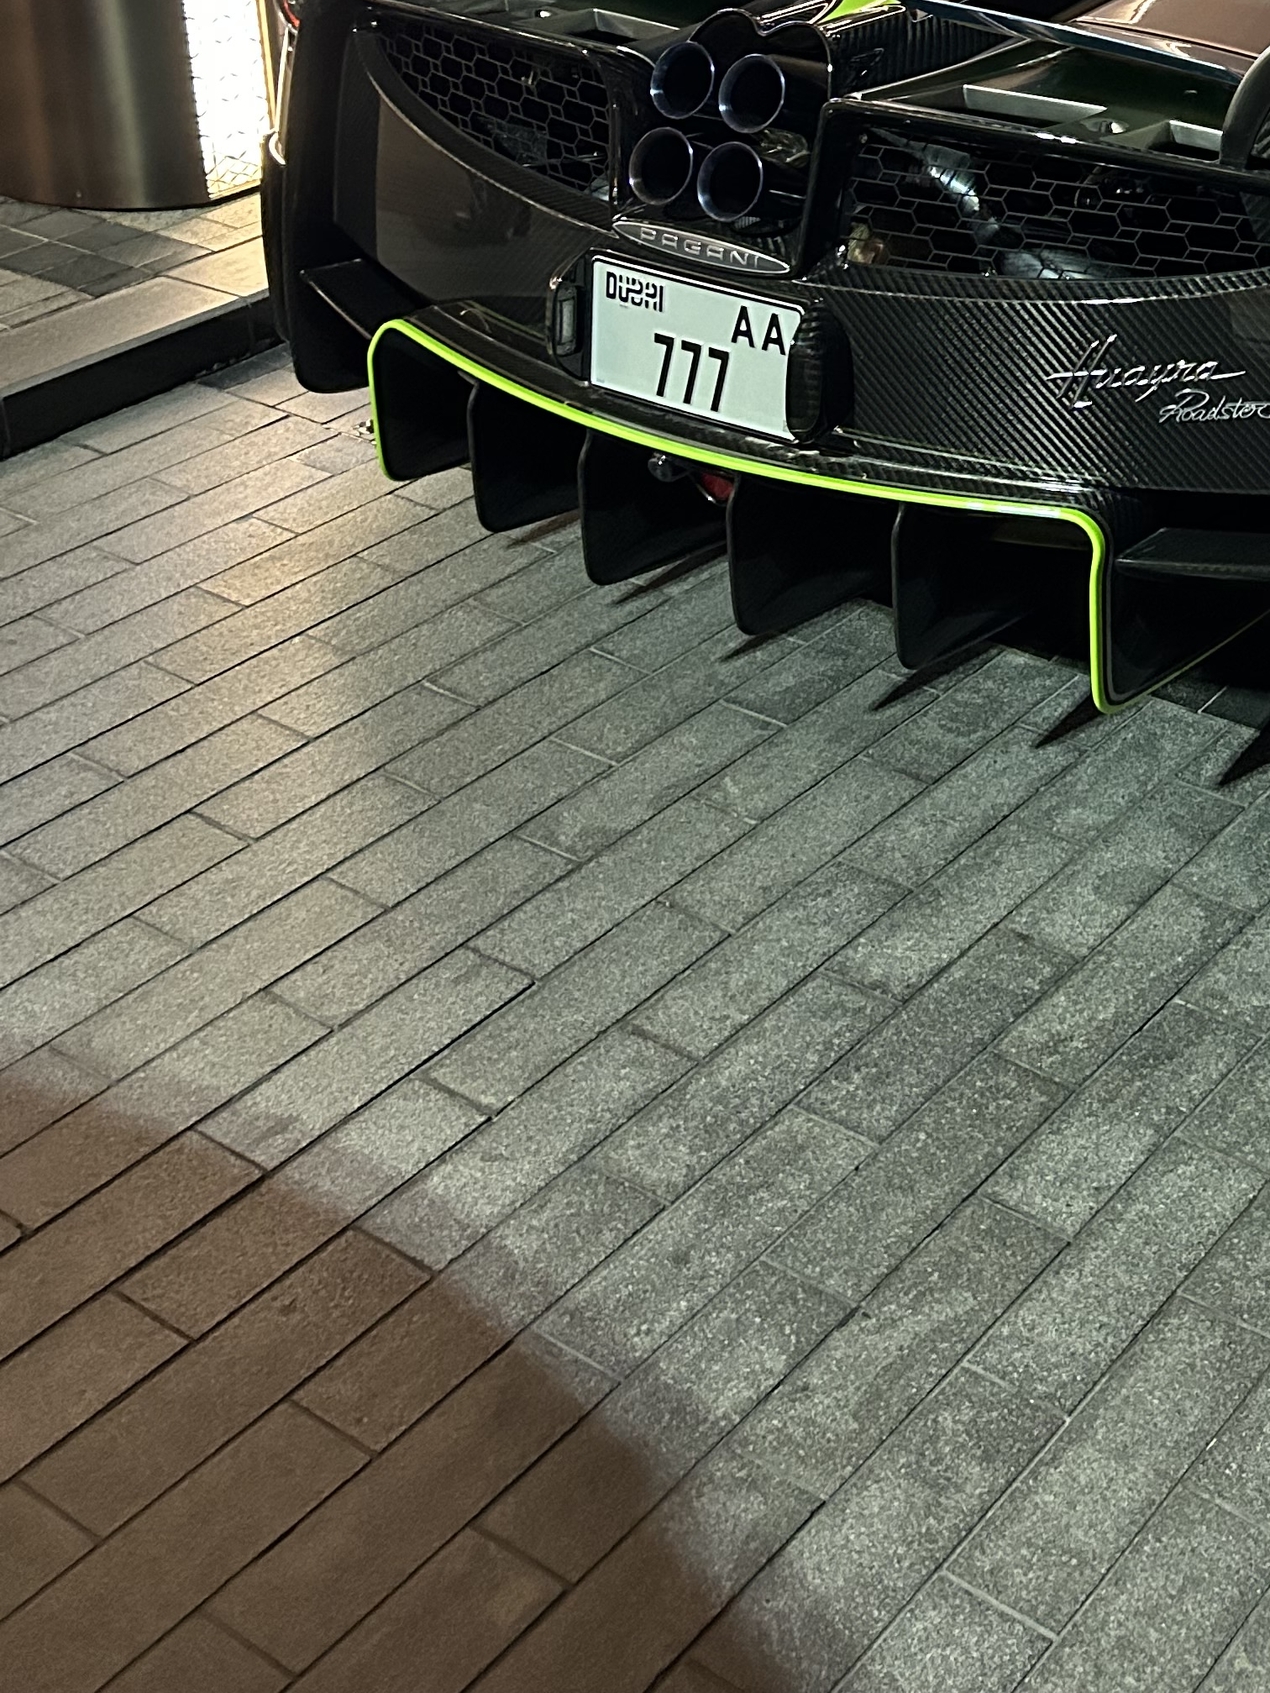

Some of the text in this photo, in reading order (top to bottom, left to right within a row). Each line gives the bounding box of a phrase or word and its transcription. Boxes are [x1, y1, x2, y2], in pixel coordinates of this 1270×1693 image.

[640, 226, 759, 268] PAGANI
[731, 305, 787, 356] AA
[653, 332, 731, 413] 777
[1046, 333, 1247, 411] Huayra
